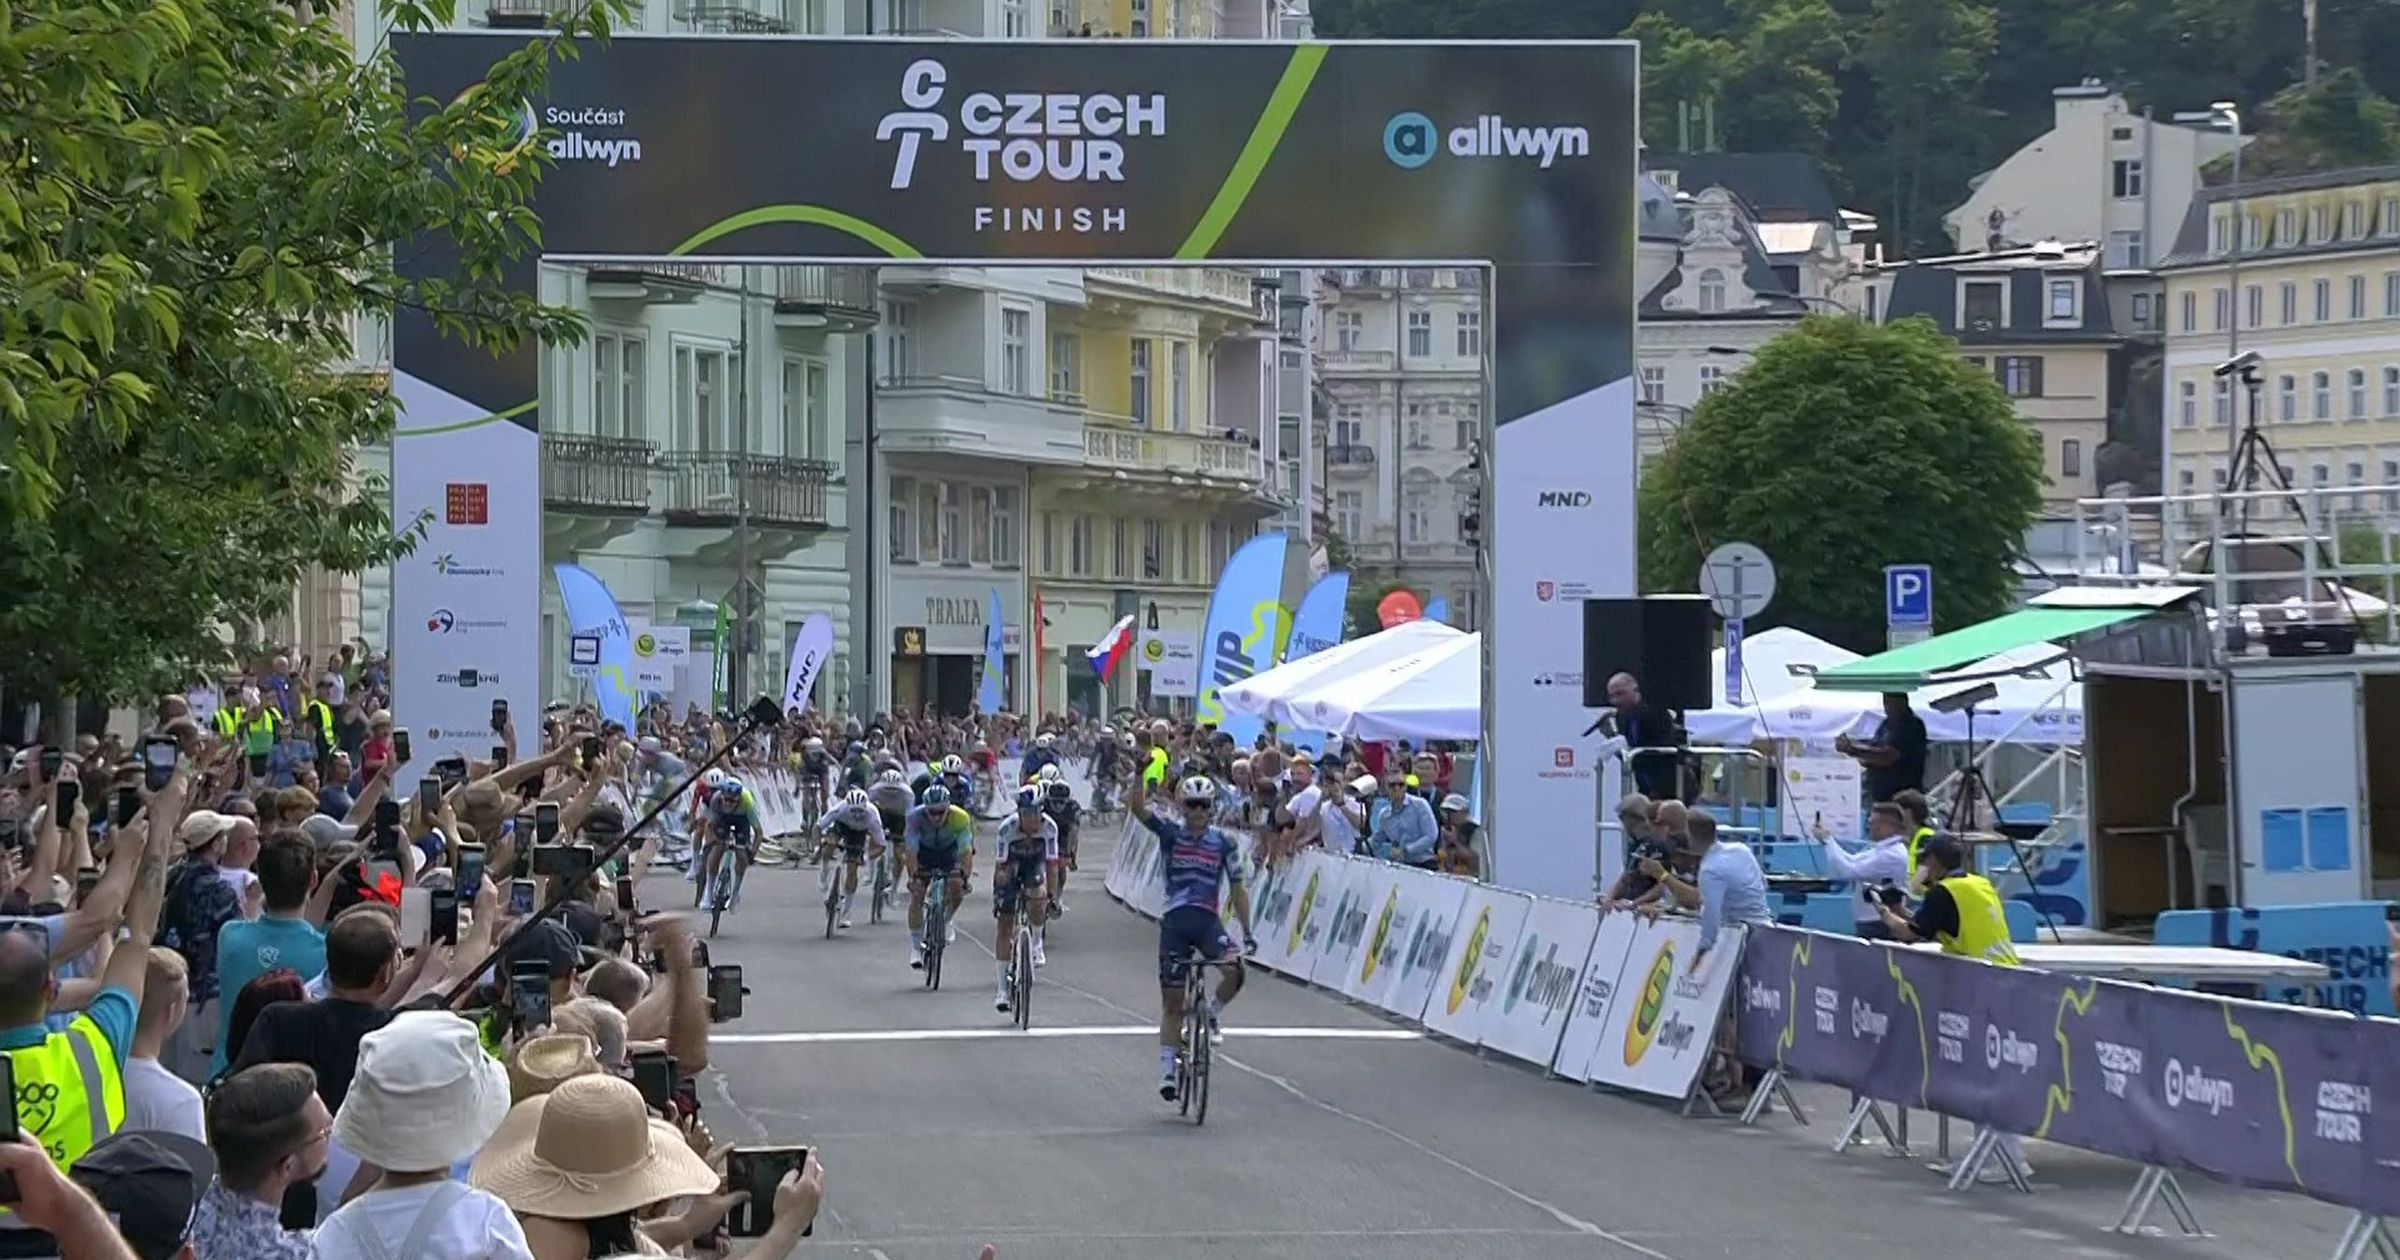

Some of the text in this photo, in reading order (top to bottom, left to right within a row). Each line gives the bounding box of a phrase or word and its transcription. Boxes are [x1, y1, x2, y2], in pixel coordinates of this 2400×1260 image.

[546, 107, 625, 126] Součást
[960, 92, 1166, 136] CZECH
[546, 132, 642, 168] allwyn
[1448, 115, 1590, 168] allwyn
[962, 138, 1125, 181] TOUR
[974, 207, 1125, 232] FINISH
[1538, 491, 1592, 507] MND
[1896, 573, 1922, 608] P
[1525, 942, 1577, 1026] allwyn
[2095, 1041, 2142, 1075] CZECH
[2186, 1065, 2233, 1115] allwyn
[2317, 1080, 2371, 1114] CZECH
[2315, 1109, 2361, 1142] TOUR
